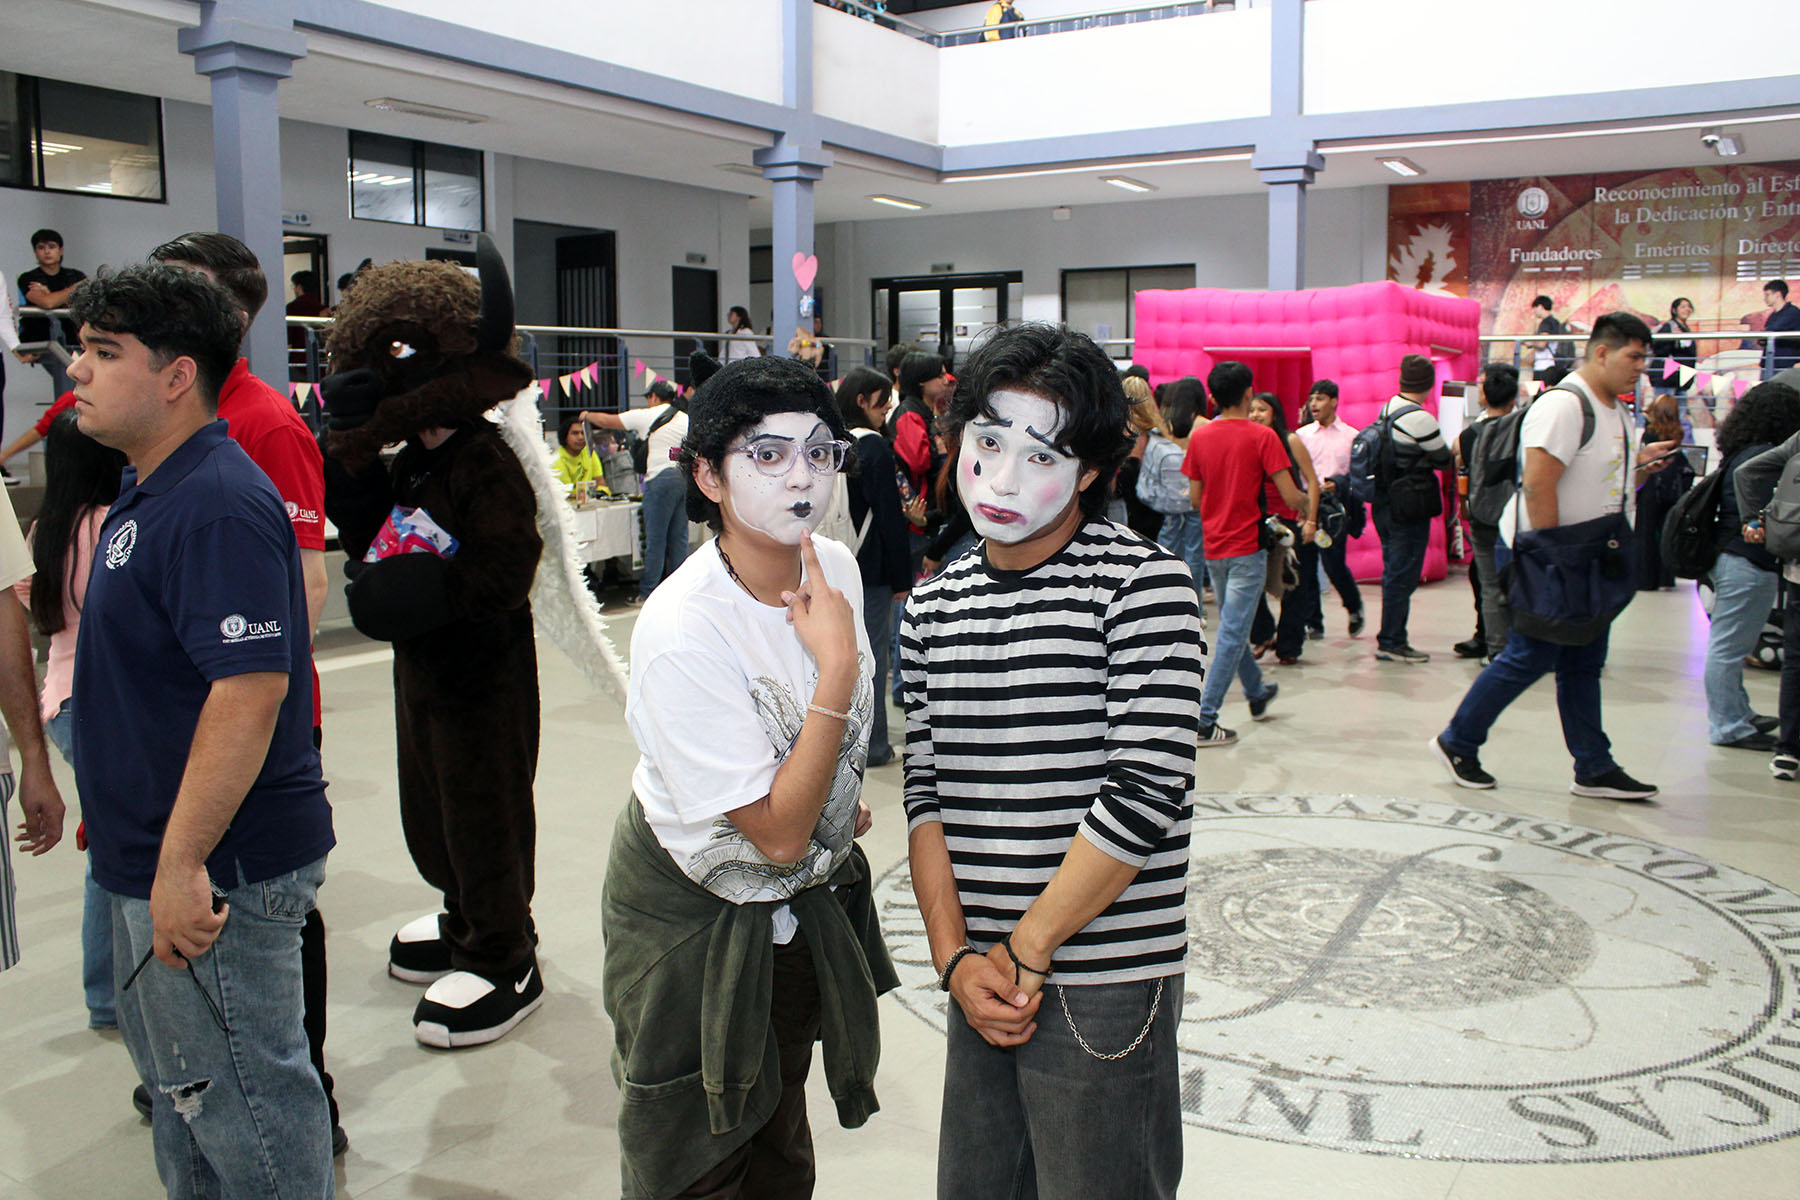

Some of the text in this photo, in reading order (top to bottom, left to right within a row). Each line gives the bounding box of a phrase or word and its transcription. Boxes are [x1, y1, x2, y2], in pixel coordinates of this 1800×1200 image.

[1594, 181, 1741, 203] Reconocimiento
[1746, 177, 1763, 194] al
[1615, 208, 1630, 224] la
[1636, 203, 1739, 223] Dedicación
[1744, 206, 1756, 222] y
[1516, 219, 1549, 230] UANL
[1510, 246, 1602, 263] Fundadores
[1635, 241, 1711, 258] Eméritos
[299, 509, 319, 519] UANL
[247, 620, 282, 635] UANL
